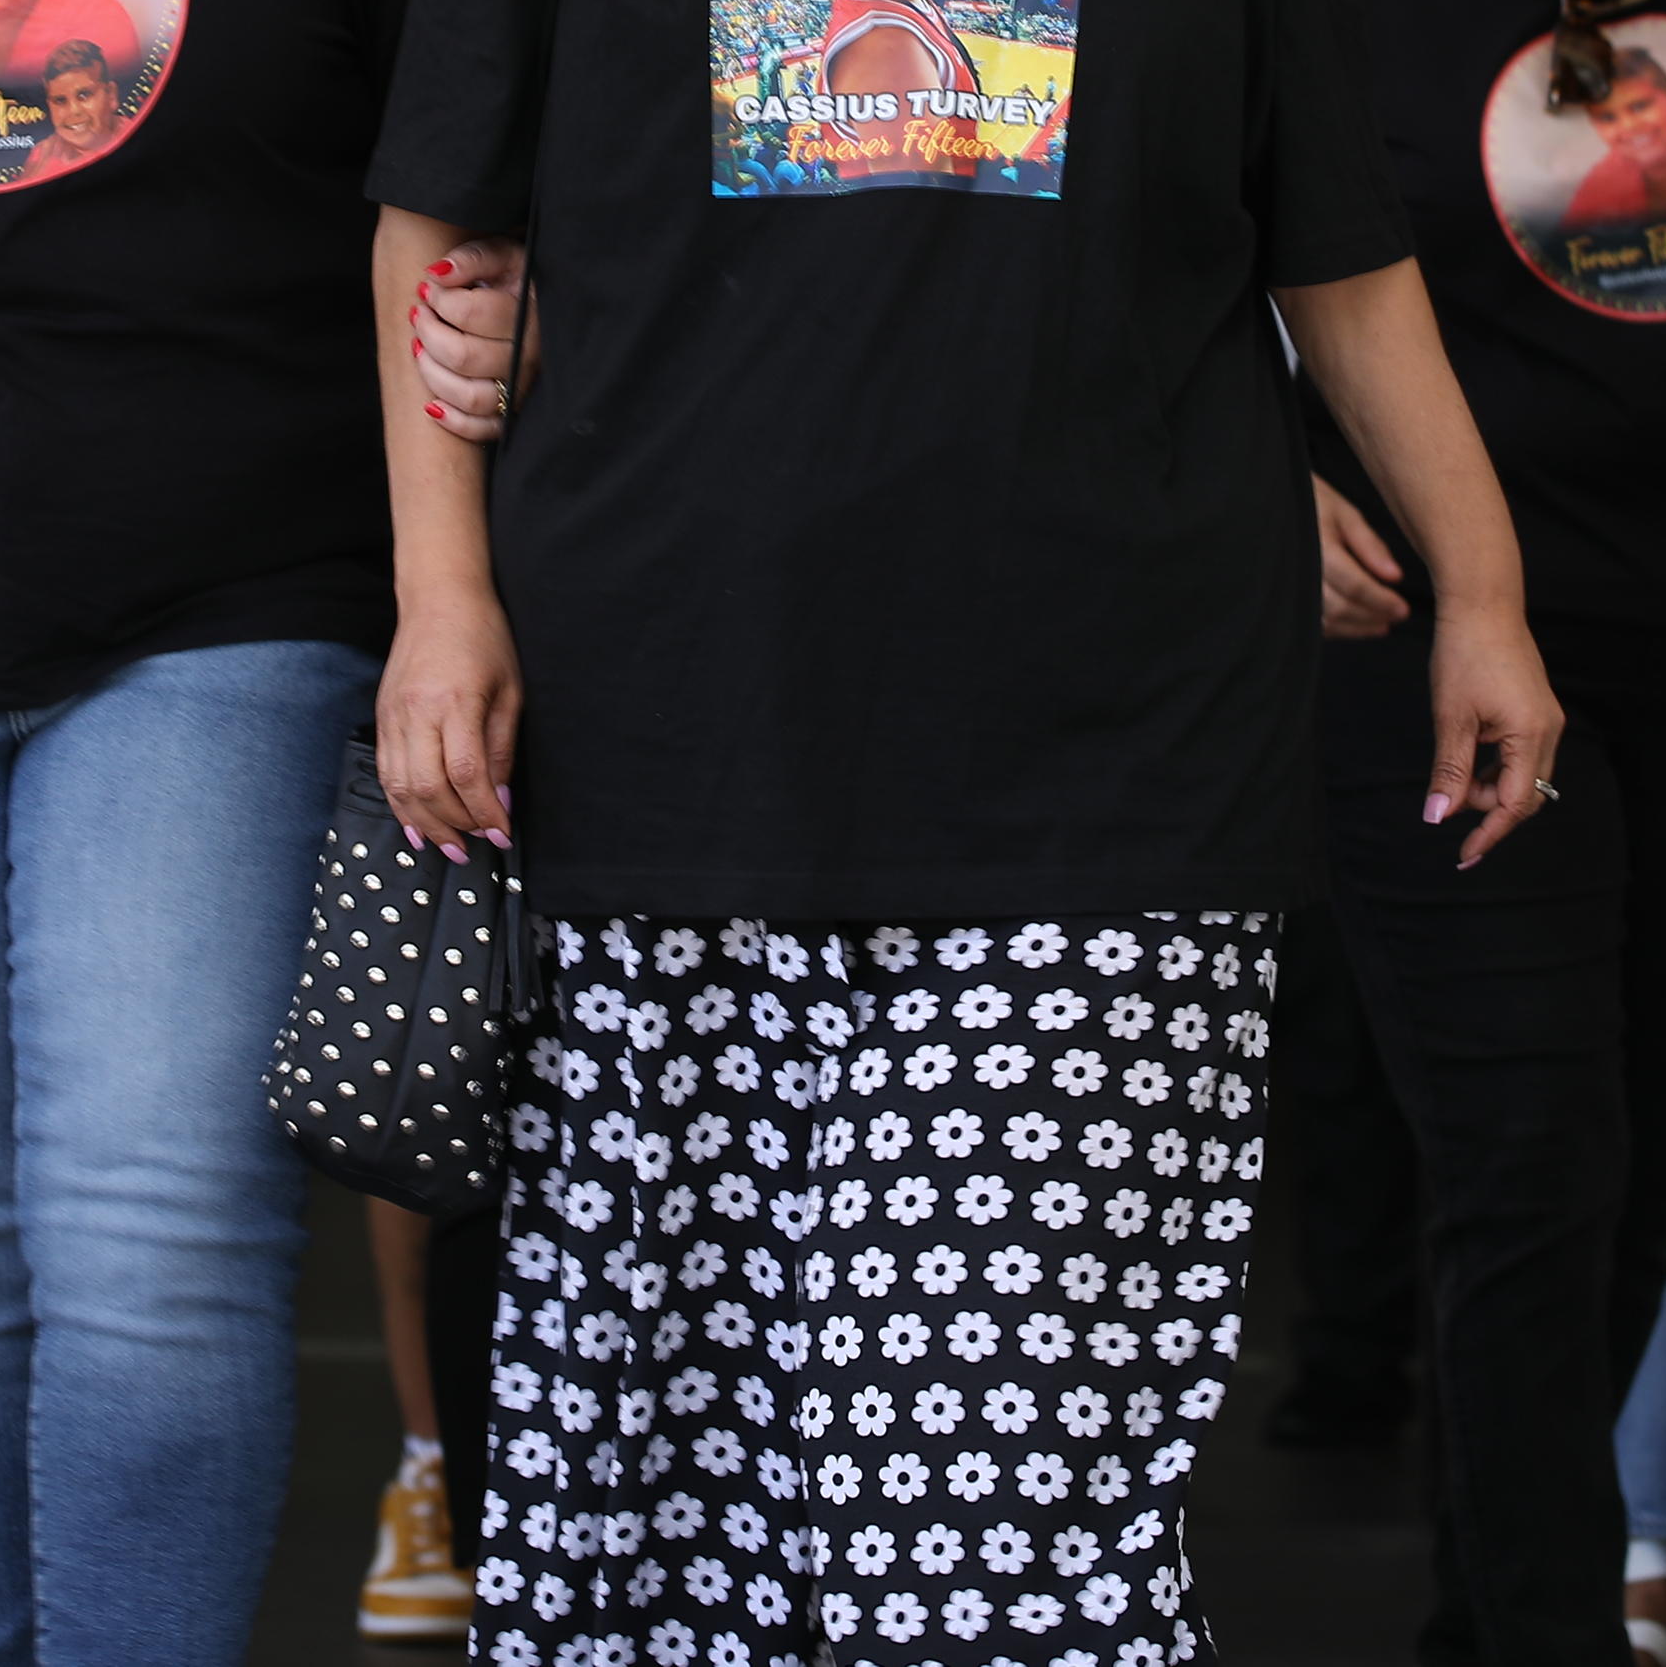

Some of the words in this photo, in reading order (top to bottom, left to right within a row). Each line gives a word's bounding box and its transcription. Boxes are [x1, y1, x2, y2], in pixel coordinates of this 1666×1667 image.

[735, 93, 900, 124] CASSIUS
[906, 90, 1058, 126] TURVEY
[786, 123, 893, 163] Forever
[901, 120, 999, 163] Fifteen
